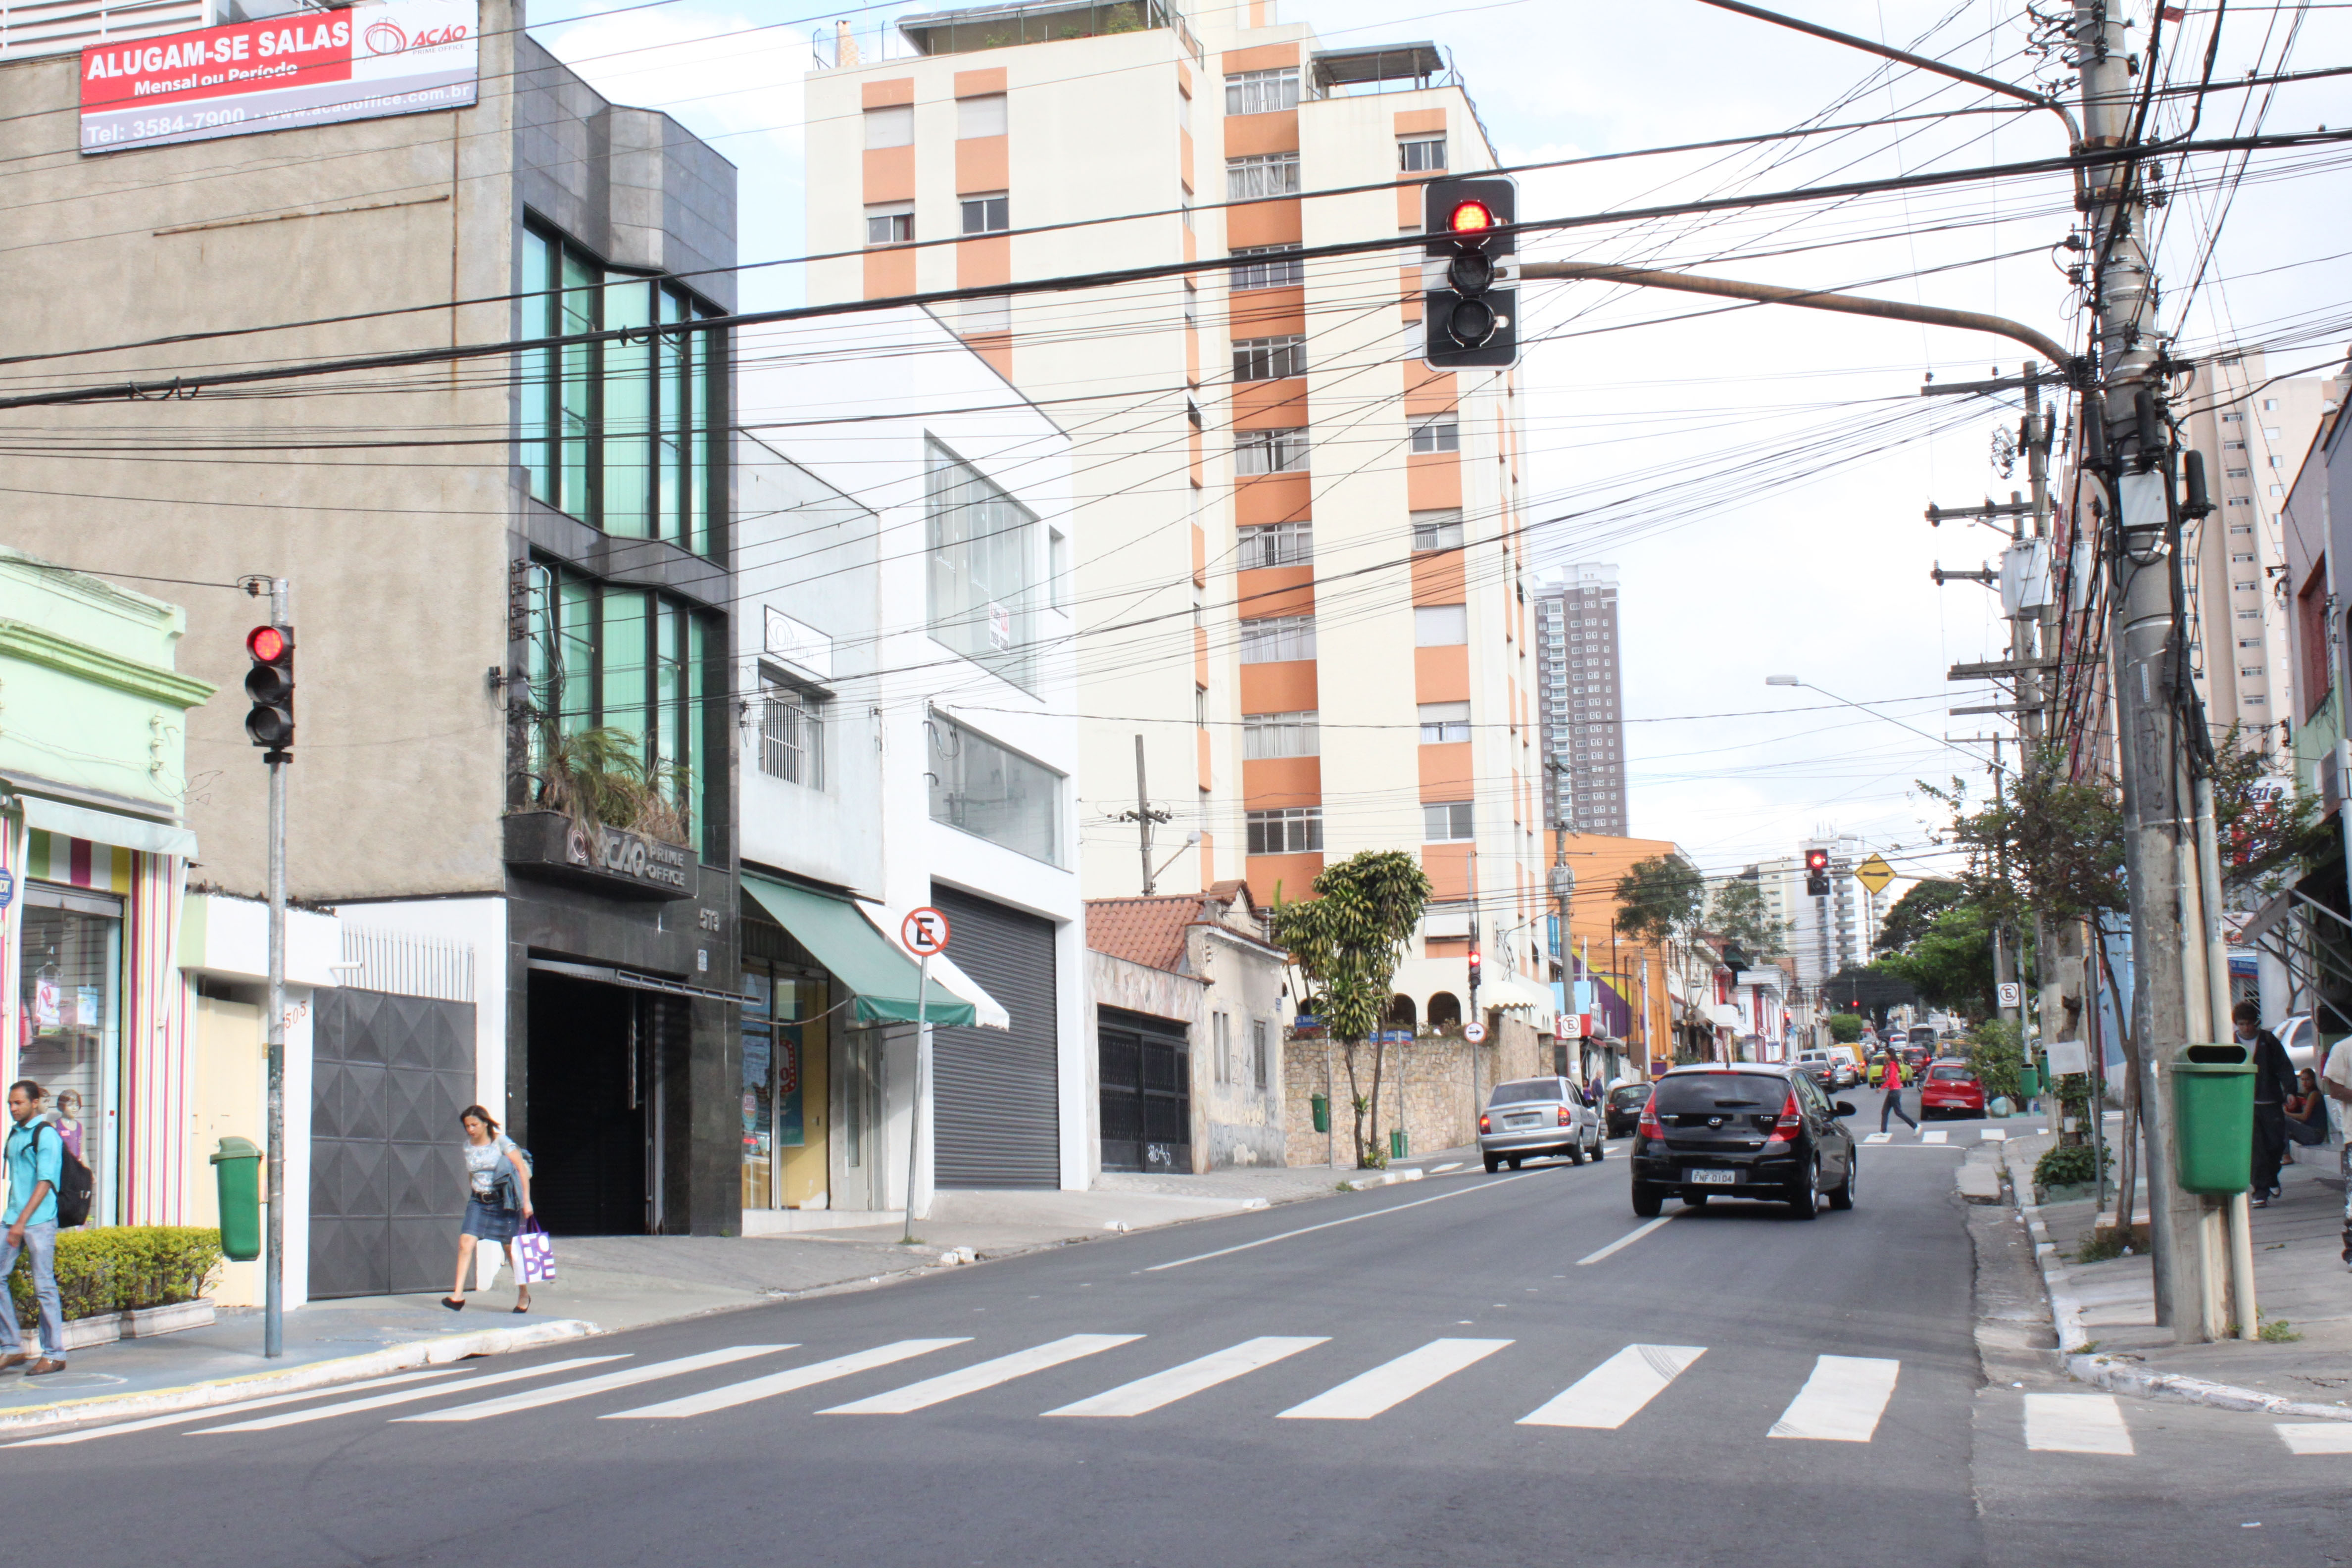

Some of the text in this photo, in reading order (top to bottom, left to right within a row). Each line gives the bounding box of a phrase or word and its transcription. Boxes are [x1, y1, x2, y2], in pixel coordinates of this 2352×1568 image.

[87, 21, 349, 80] ALUGAM-SE SALAS
[134, 62, 298, 96] Mensal ou Período
[87, 124, 125, 143] Tel:
[133, 108, 245, 138] 3584-7900
[649, 845, 684, 867] PRIME
[647, 864, 685, 886] OFFICE
[699, 908, 720, 931] 573
[916, 917, 934, 946] E
[2005, 988, 2012, 998] E
[1568, 1020, 1574, 1029] E
